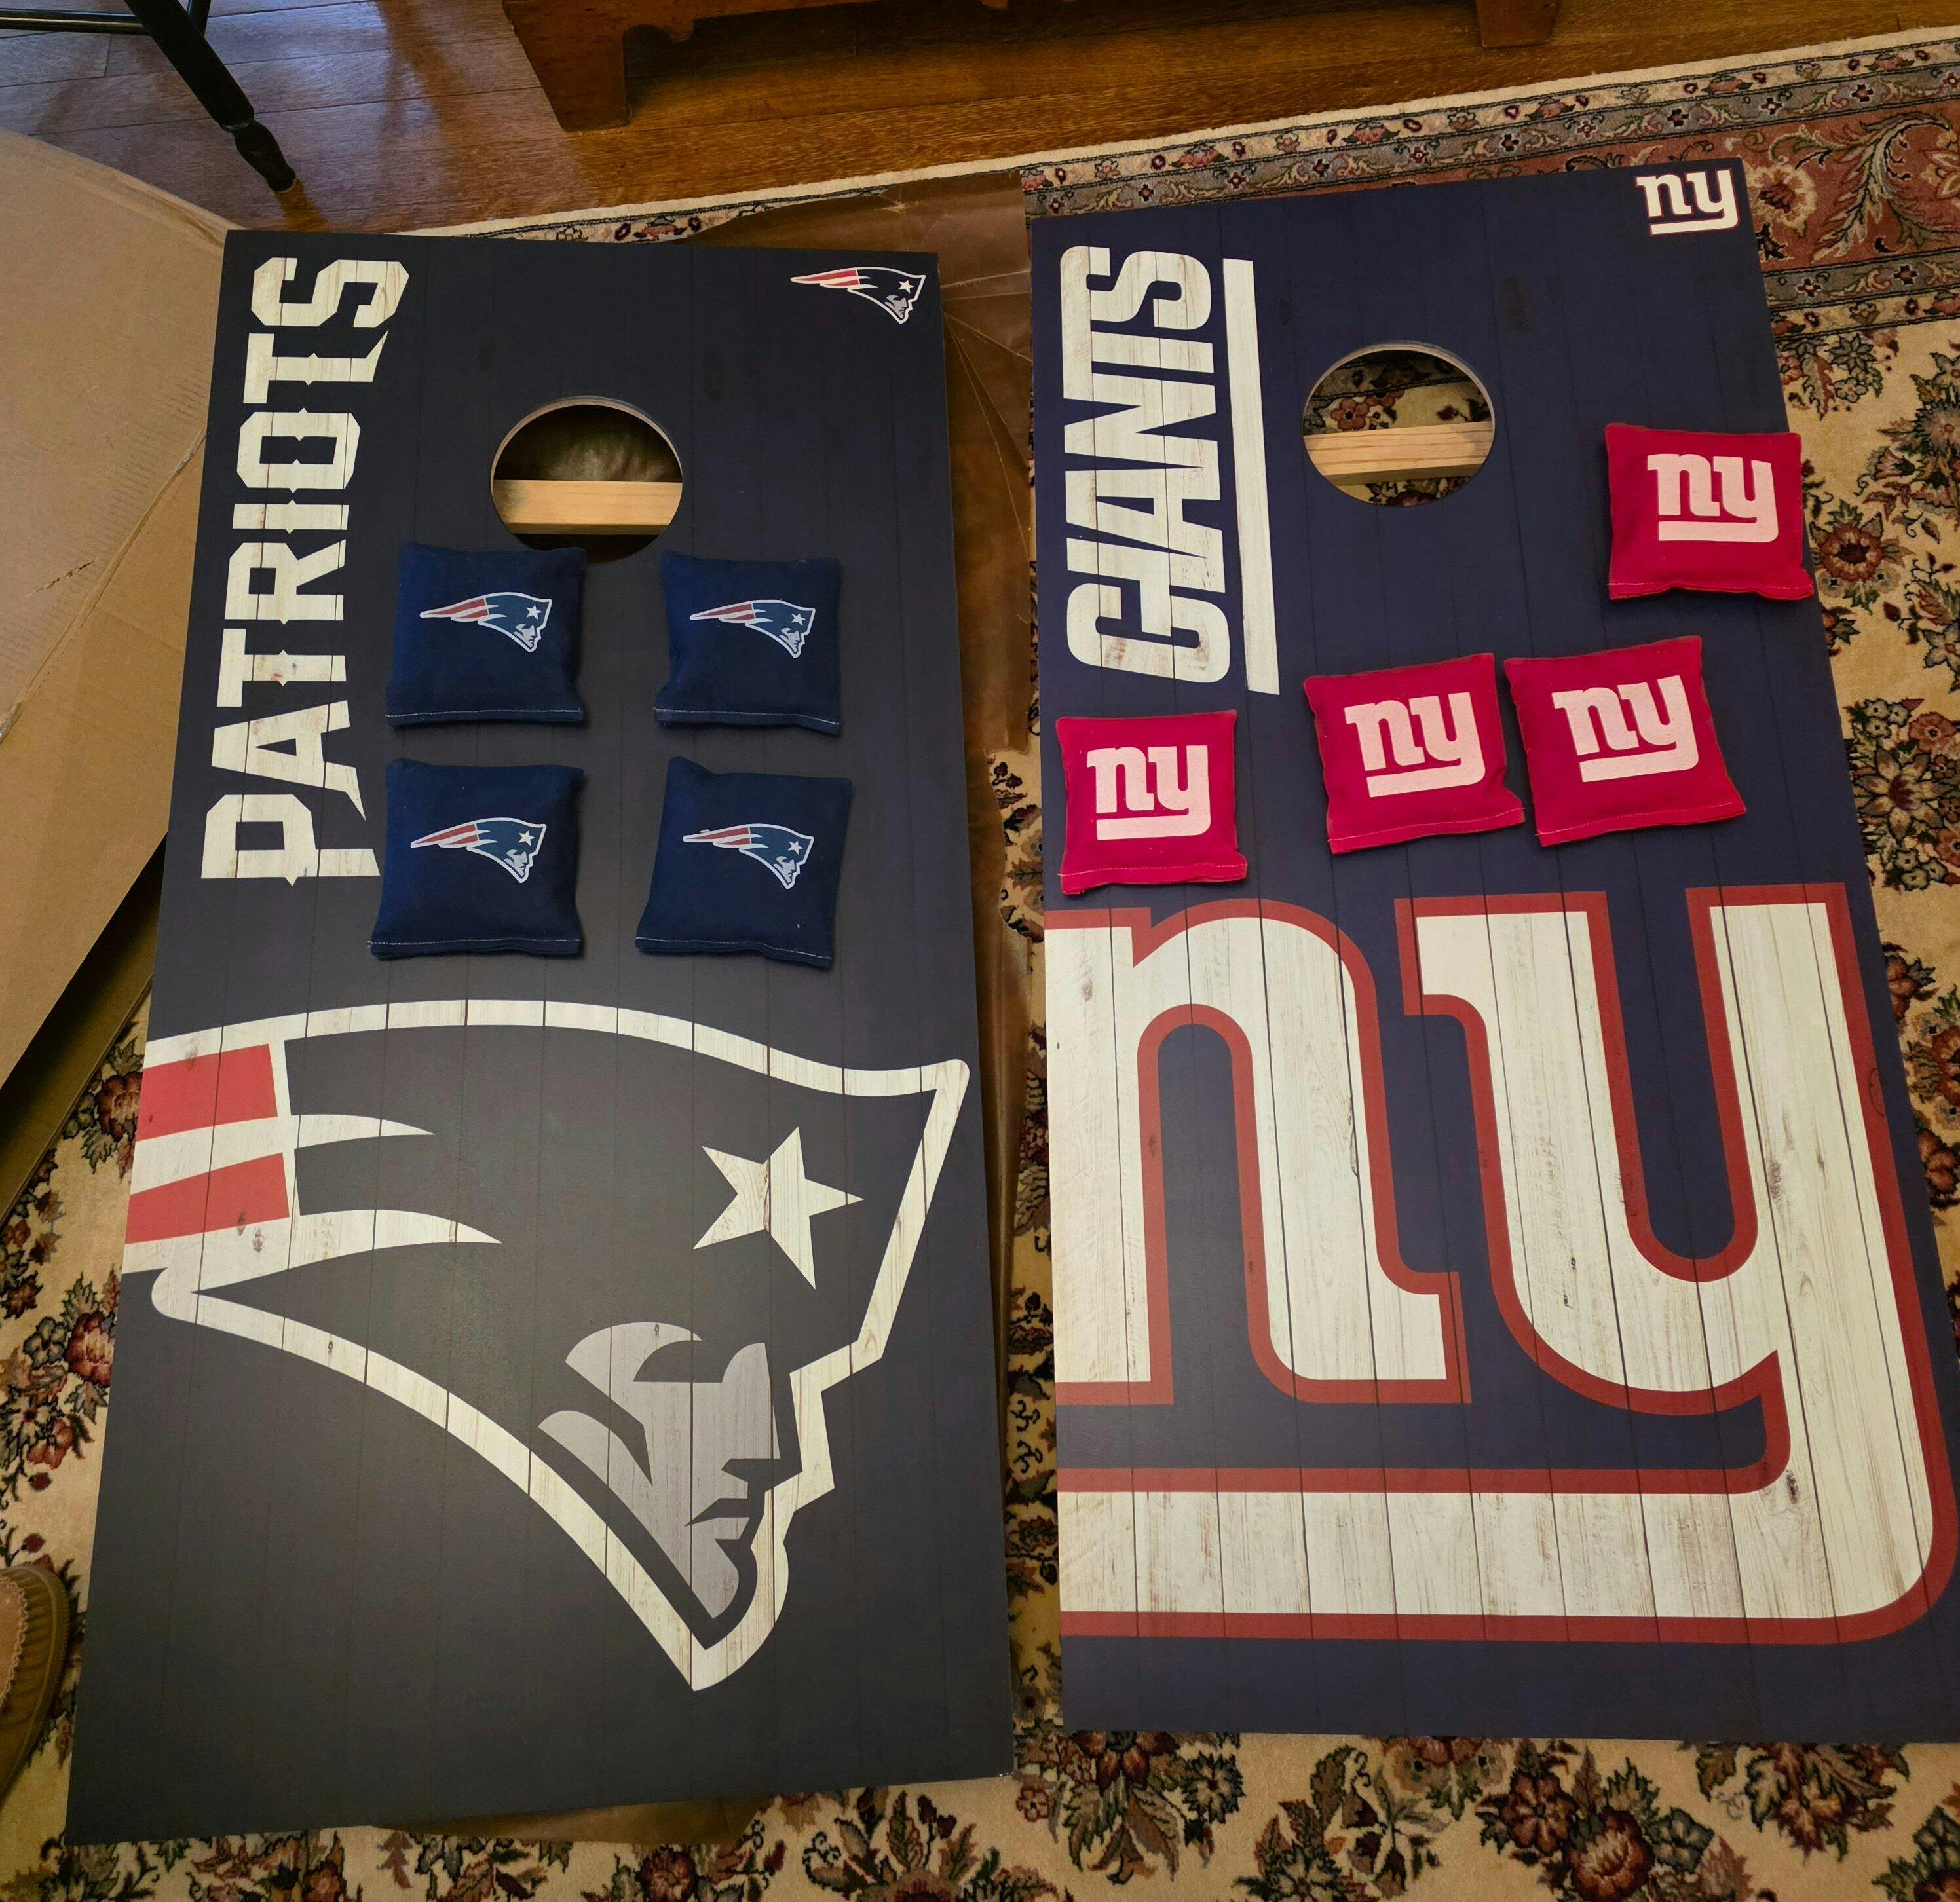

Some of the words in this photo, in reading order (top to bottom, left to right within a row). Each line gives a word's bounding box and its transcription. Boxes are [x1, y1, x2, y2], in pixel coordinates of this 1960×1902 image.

[1635, 168, 1741, 236] ny
[1060, 245, 1231, 684] GIANTS
[1646, 453, 1779, 543] ny
[200, 256, 410, 886] PATRIOTS
[1344, 692, 1486, 798] ny
[1551, 675, 1699, 783] ny
[1086, 744, 1211, 841] ny
[1043, 882, 1957, 1645] ny
